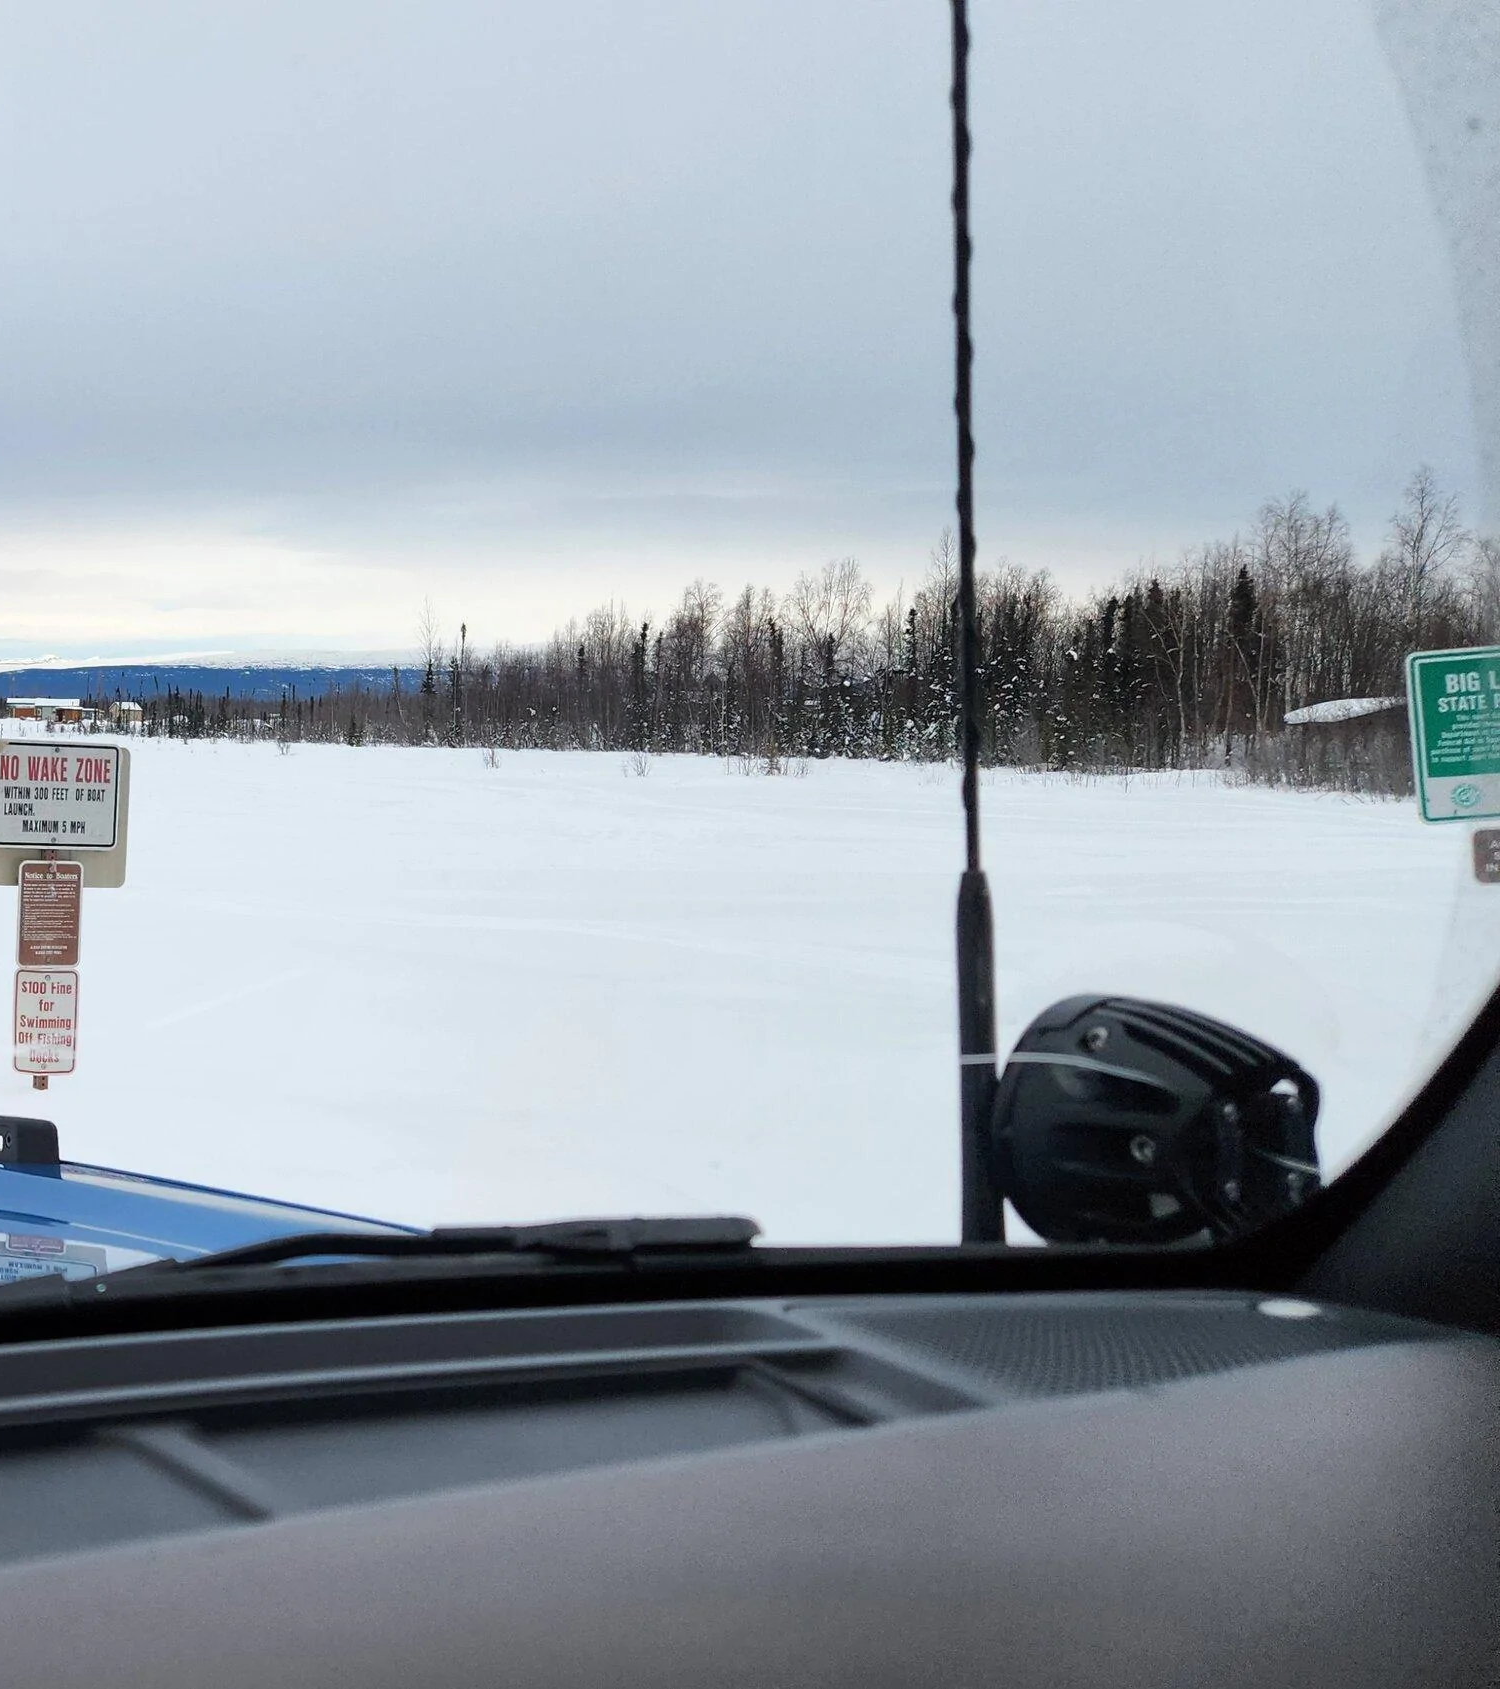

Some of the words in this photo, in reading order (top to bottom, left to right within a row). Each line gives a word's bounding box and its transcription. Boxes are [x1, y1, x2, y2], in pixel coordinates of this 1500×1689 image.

[1445, 671, 1481, 694] BIG
[1437, 694, 1488, 713] STATE
[0, 755, 20, 780] NO
[28, 756, 68, 782] WAKE
[75, 758, 111, 784] ZONE
[4, 786, 31, 800] WITHIN
[34, 787, 49, 800] 300
[52, 788, 69, 801] FEET
[75, 788, 84, 801] OF
[87, 789, 106, 802] BOAT
[3, 803, 35, 817] LAUNCH.
[22, 820, 59, 834] MAXIMUM
[62, 821, 67, 833] 5
[70, 821, 86, 834] MPH
[51, 982, 72, 995] Fine
[39, 999, 54, 1012] for
[20, 1015, 72, 1031] Swimming
[18, 1031, 33, 1045] Off
[37, 1033, 72, 1047] Fishing
